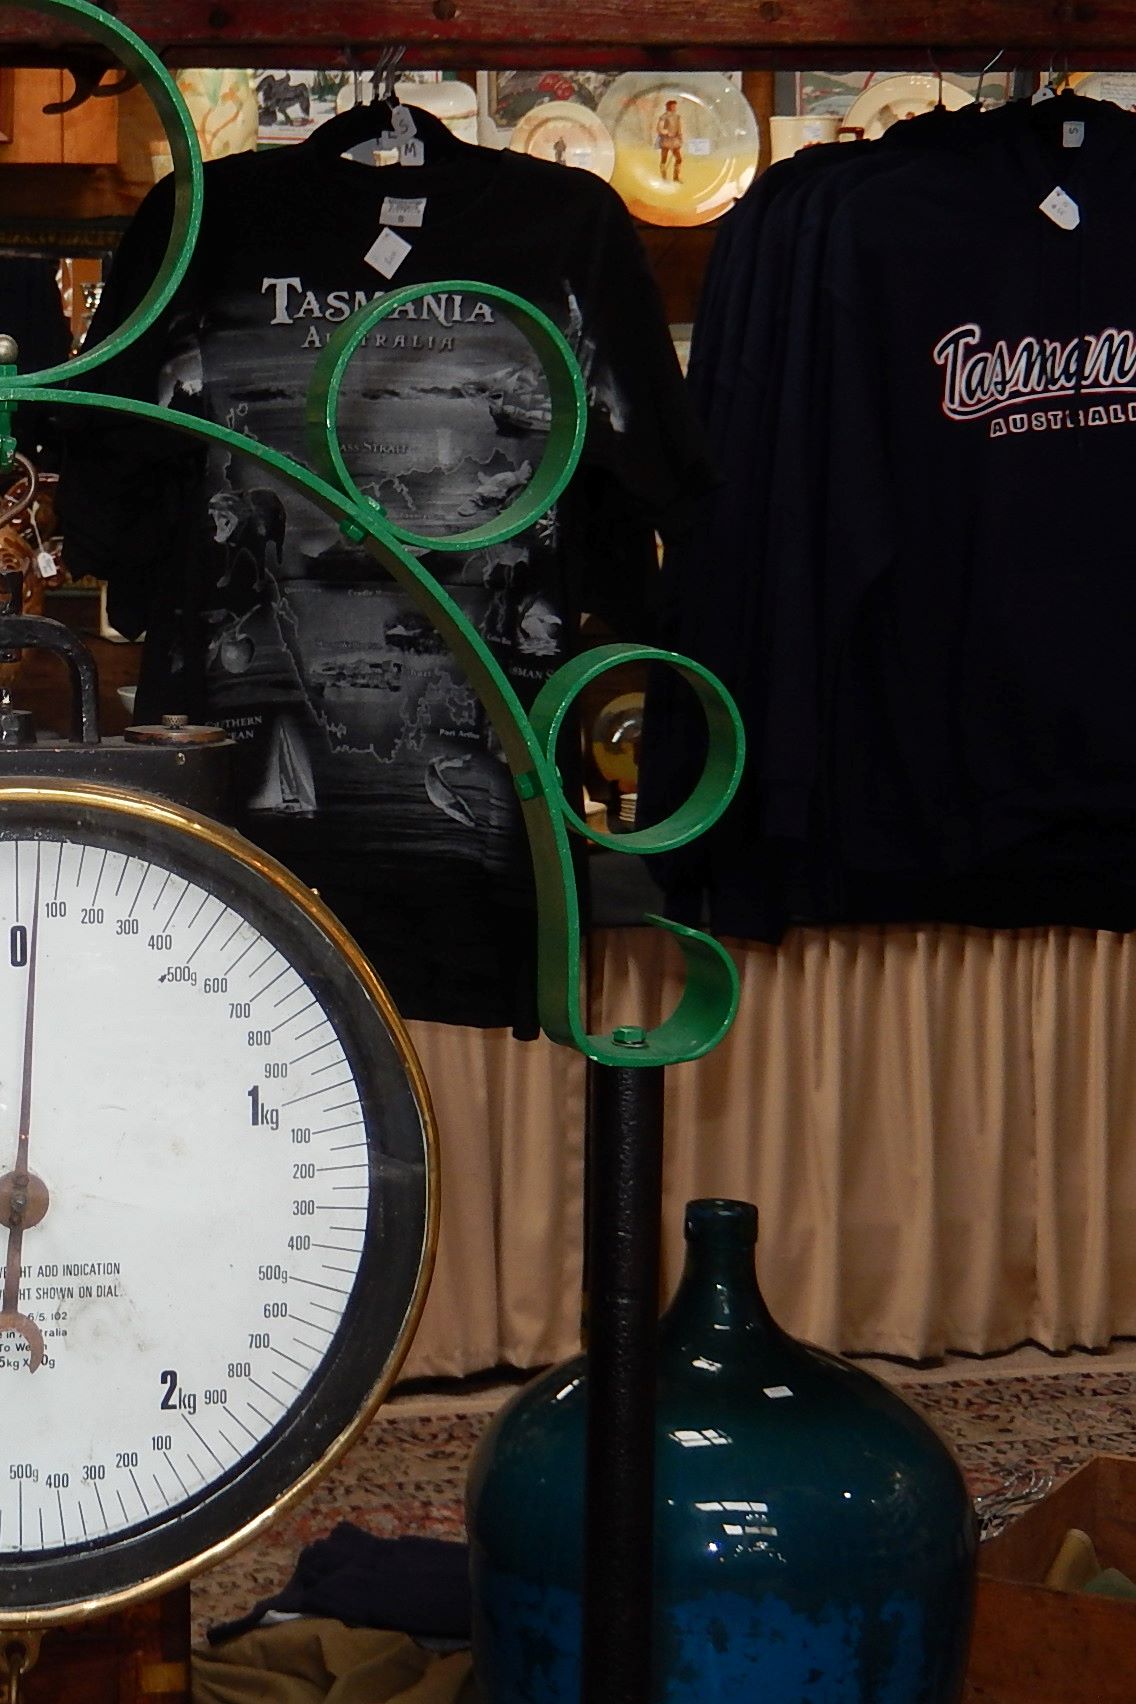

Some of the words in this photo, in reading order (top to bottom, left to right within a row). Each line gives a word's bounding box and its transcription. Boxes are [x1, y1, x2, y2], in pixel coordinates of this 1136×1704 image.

[404, 142, 417, 158] M
[300, 325, 456, 353] ARALIA
[46, 902, 66, 918] 100
[81, 909, 104, 924] 200
[116, 919, 138, 935] 300
[10, 925, 27, 967] 0
[148, 935, 172, 950] 400
[166, 966, 197, 986] 500g
[204, 978, 227, 993] 600
[229, 1003, 250, 1018] 700
[248, 1030, 271, 1046] 800
[265, 1063, 287, 1078] 900
[247, 1084, 280, 1130] 1kg
[291, 1128, 310, 1143] 100
[293, 1164, 315, 1179] 200
[293, 1200, 314, 1215] 300
[288, 1235, 310, 1250] 400
[37, 1264, 58, 1278] ADD
[62, 1262, 121, 1277] INDICATION
[259, 1265, 287, 1283] 500g
[35, 1286, 74, 1300] SHOWN
[78, 1286, 93, 1299] ON
[264, 1302, 287, 1318] 600
[6, 1330, 16, 1339] in
[249, 1333, 270, 1349] 700
[228, 1363, 251, 1378] 800
[160, 1369, 197, 1416] 2kg
[205, 1389, 227, 1405] 900
[152, 1435, 171, 1451] 100
[116, 1452, 138, 1468] 200
[10, 1464, 38, 1482] 500g
[46, 1473, 69, 1488] 400
[83, 1465, 105, 1482] 300
